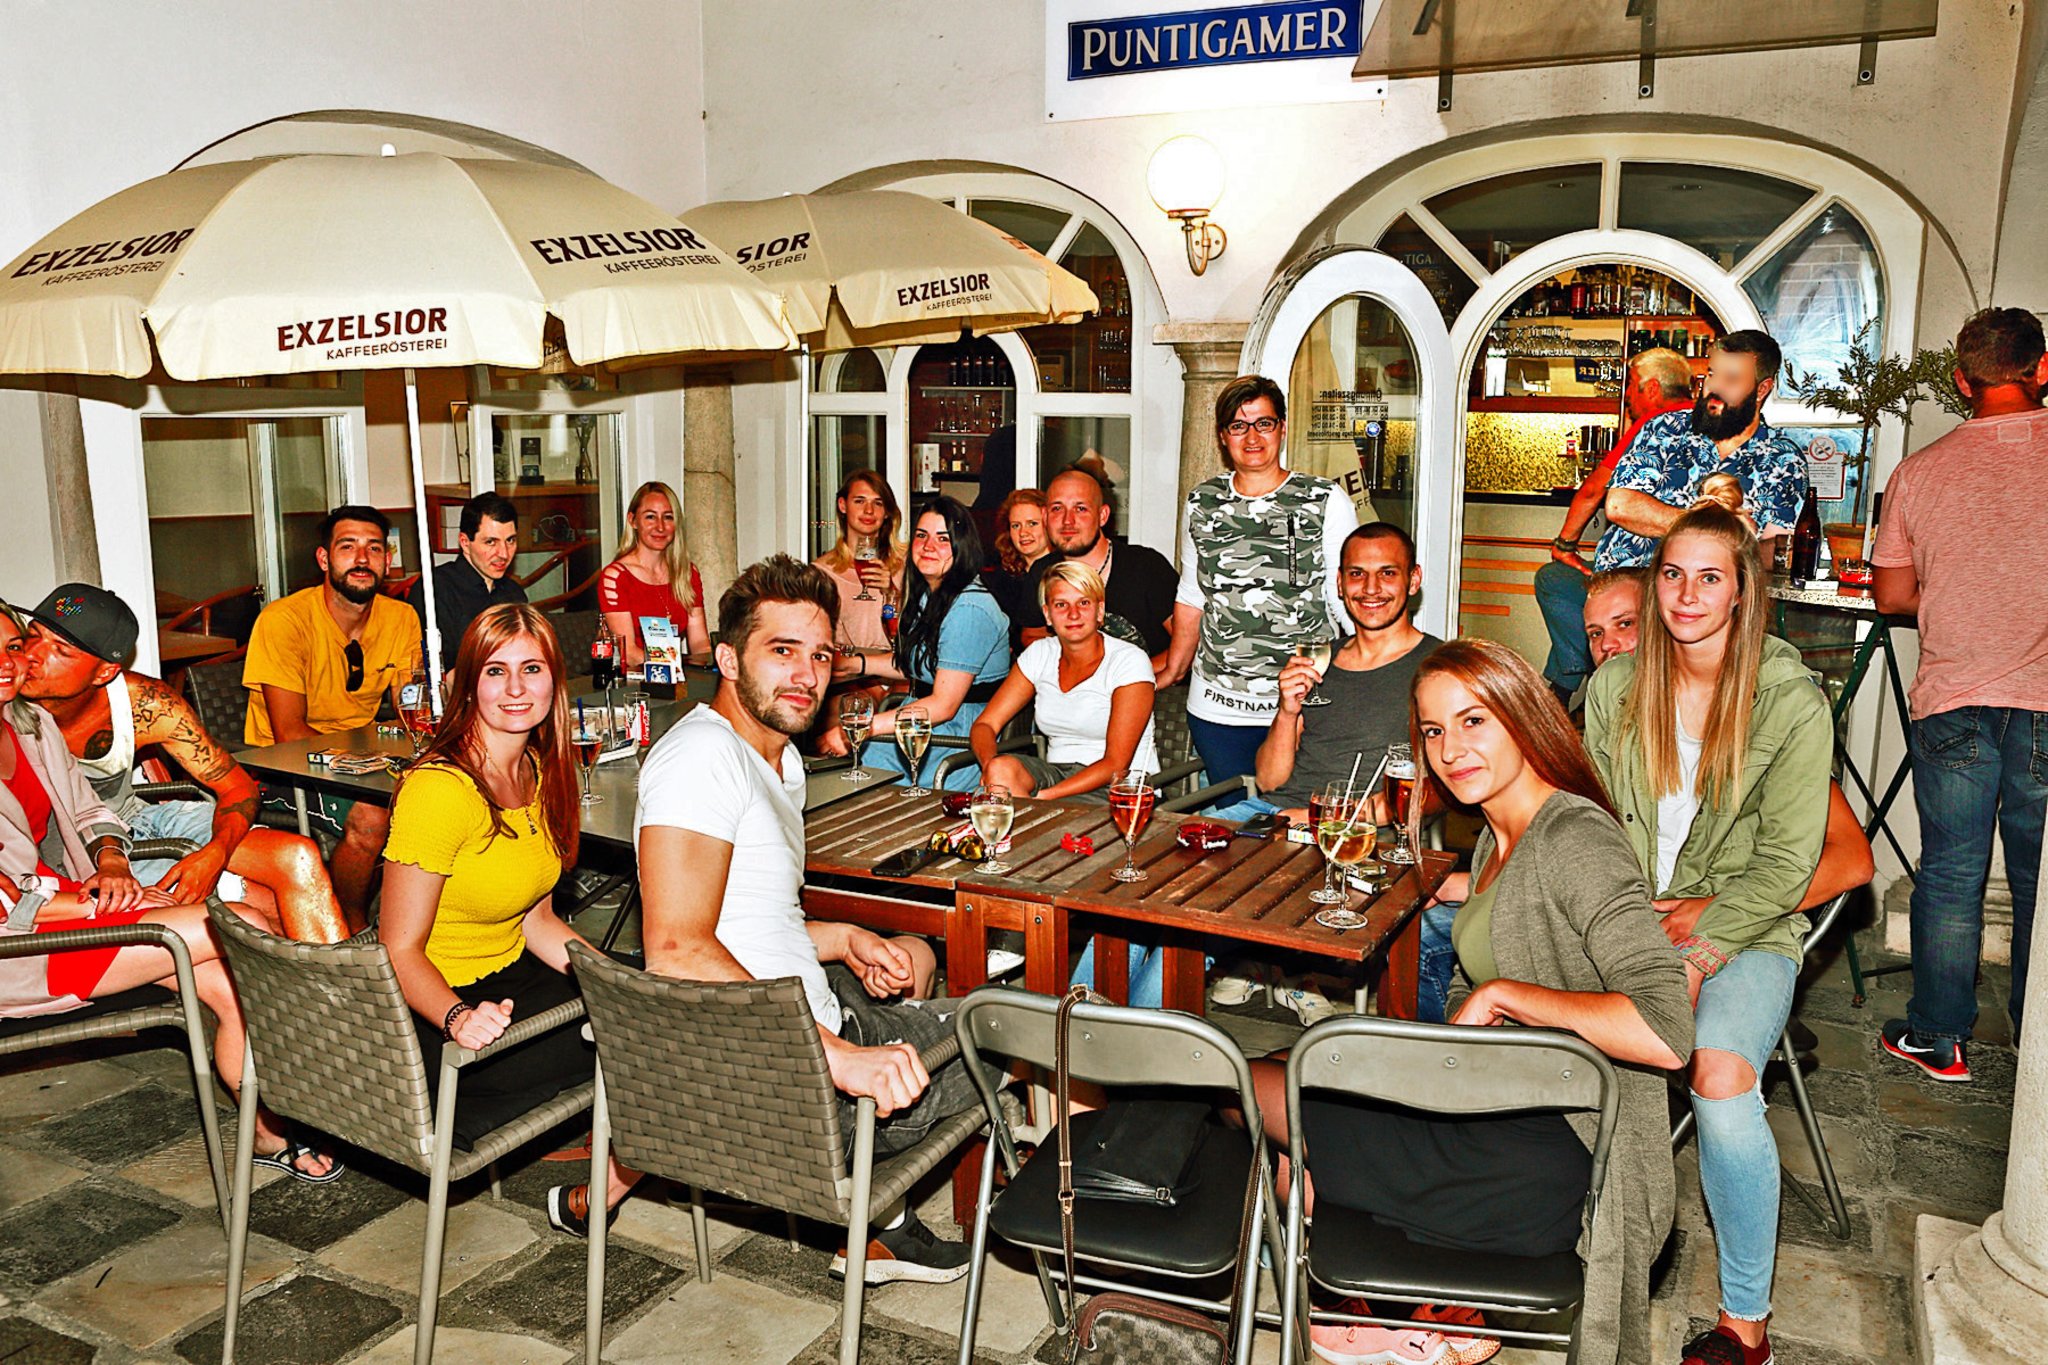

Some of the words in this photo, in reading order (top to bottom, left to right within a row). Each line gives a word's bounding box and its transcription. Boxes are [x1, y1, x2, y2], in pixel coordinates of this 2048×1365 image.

[1082, 7, 1347, 71] PUNTIGAMER
[10, 227, 195, 279] EXZELSIOR
[530, 228, 706, 265] EXZELSIOR
[736, 232, 811, 265] SIOR
[41, 261, 165, 287] KAFFEERÖSTEREI
[604, 255, 721, 274] KAFFEERÖSTEREI
[897, 273, 990, 306] EXZELSIOR
[277, 307, 447, 352] EXZELSIOR
[326, 339, 448, 360] KAFFEERÖSTEREI
